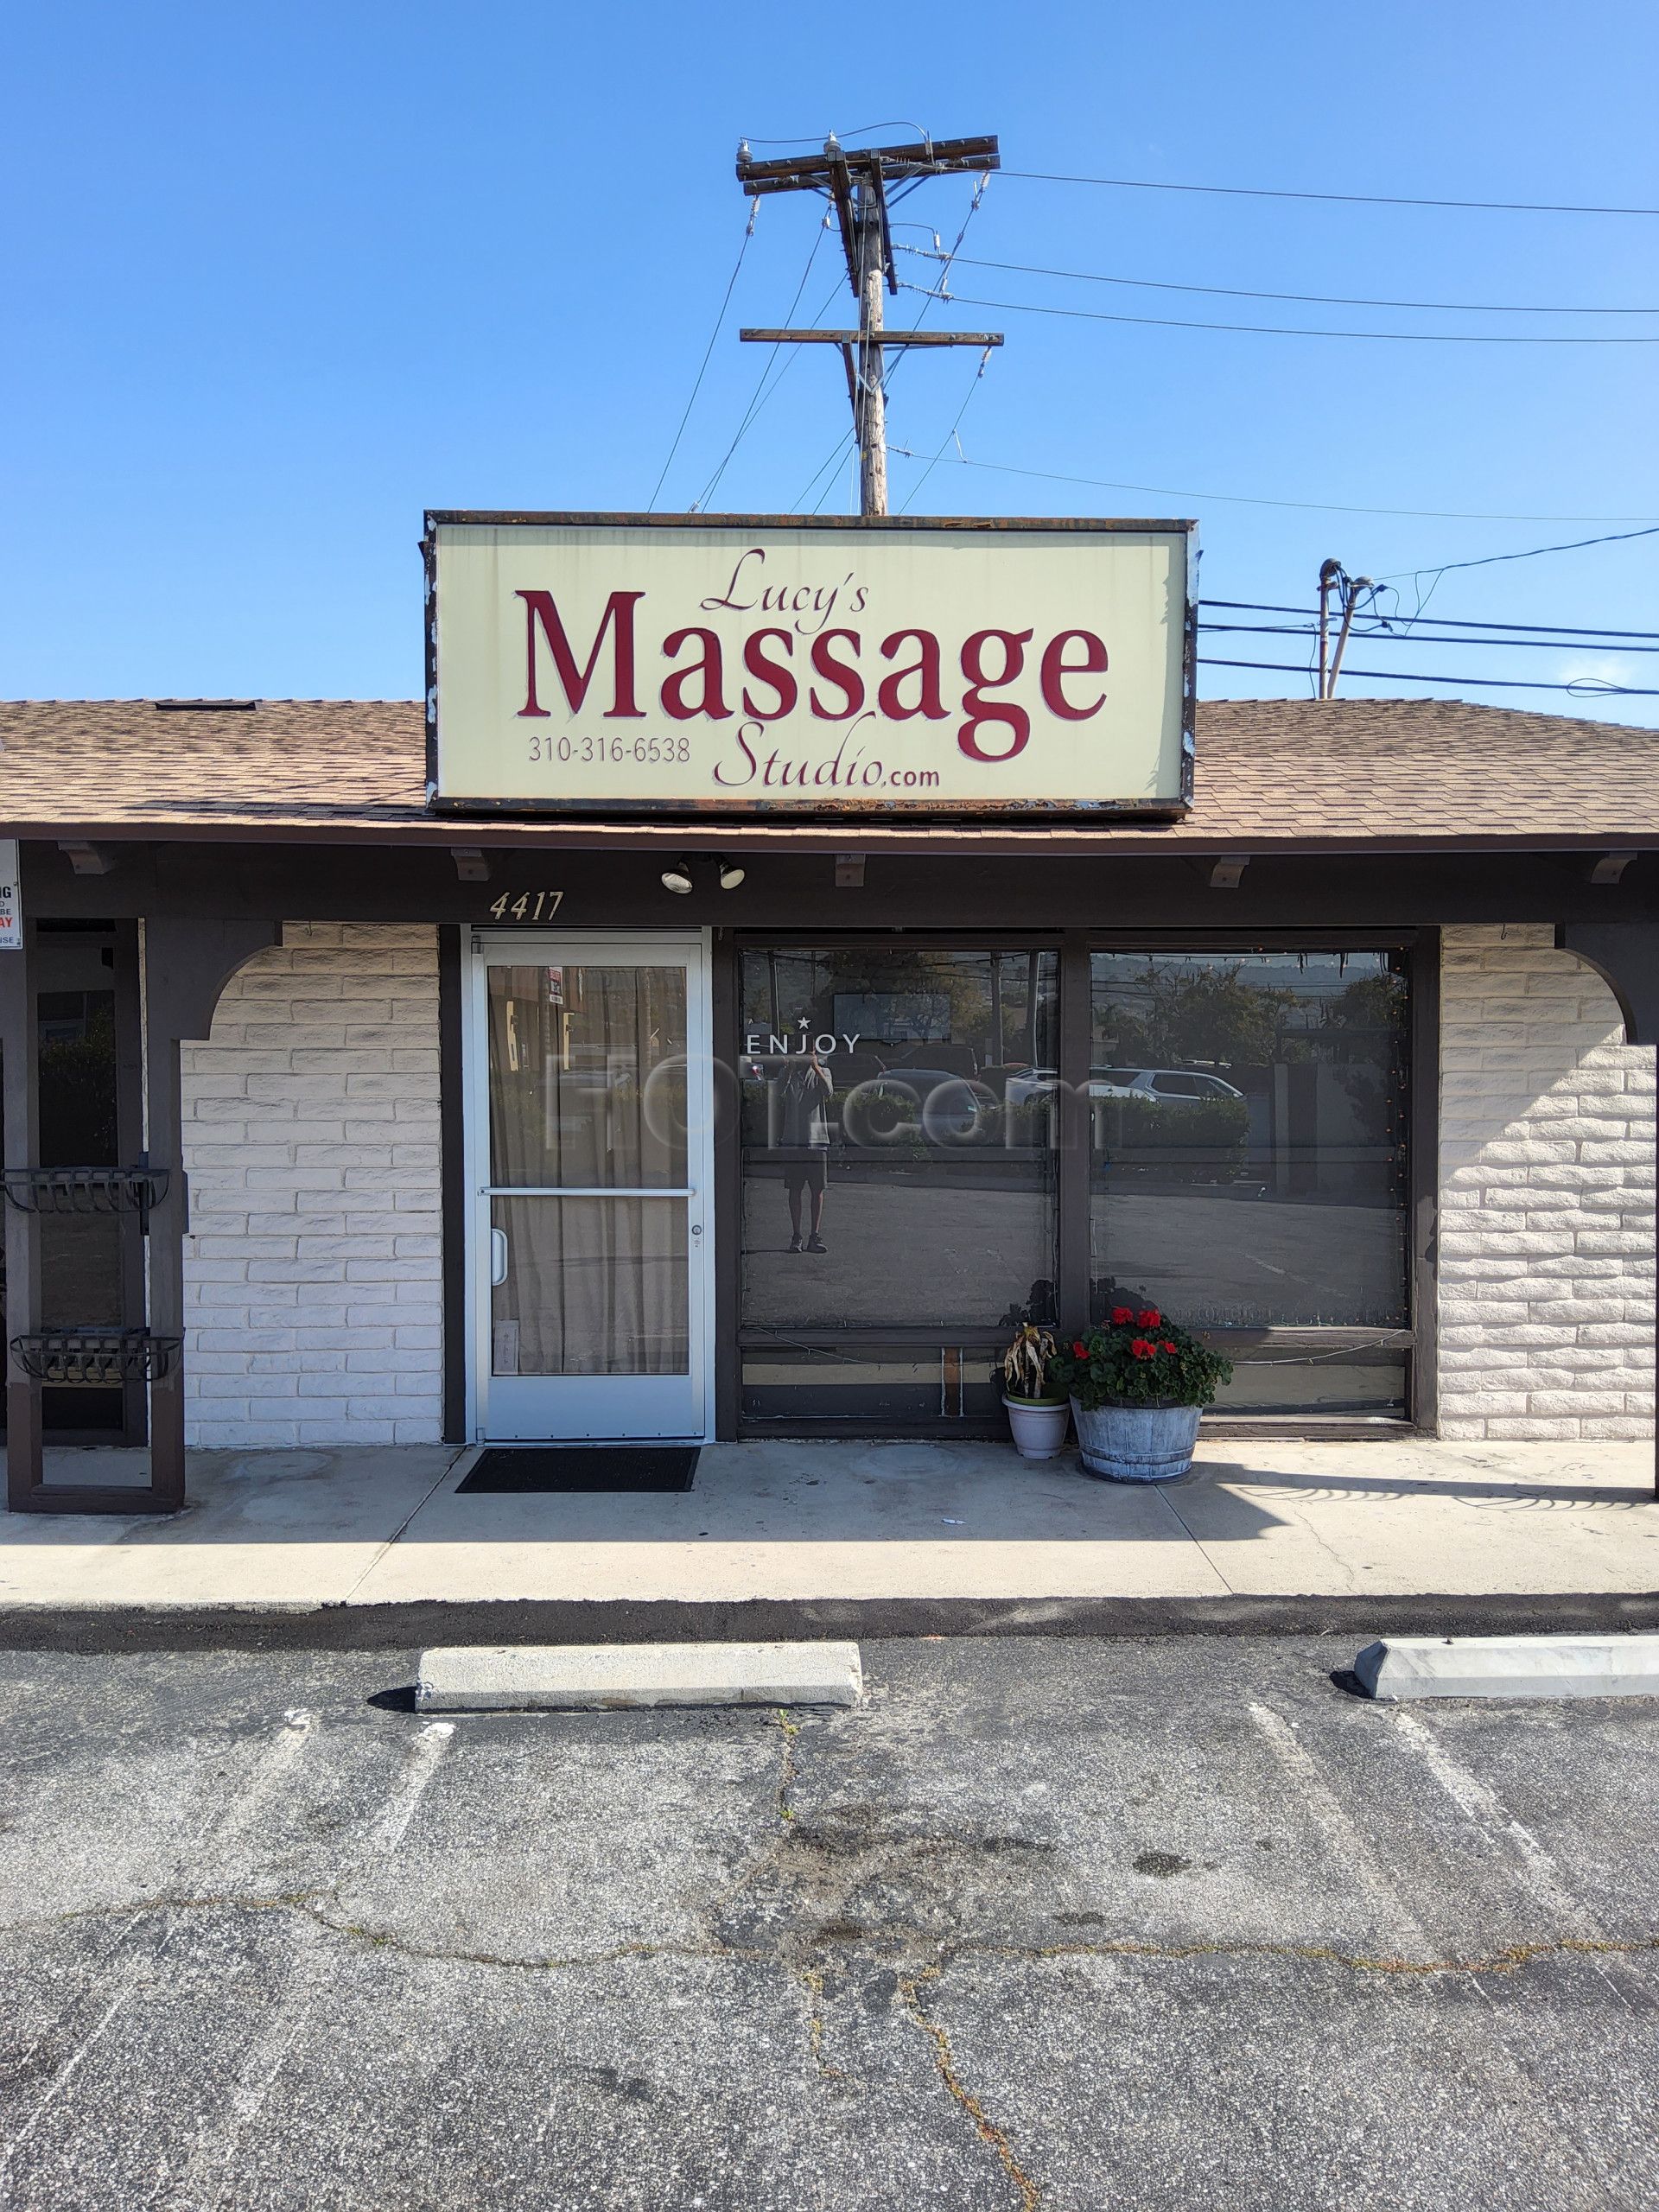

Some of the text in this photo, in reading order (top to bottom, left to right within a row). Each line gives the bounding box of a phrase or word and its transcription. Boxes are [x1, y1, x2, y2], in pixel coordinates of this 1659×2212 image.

[700, 548, 868, 634] Lucy's
[514, 590, 1109, 763] Massage
[529, 736, 690, 763] 310-316-6538
[714, 710, 939, 786] Studio.com
[490, 891, 564, 920] 4417
[747, 1033, 861, 1055] ENJOY
